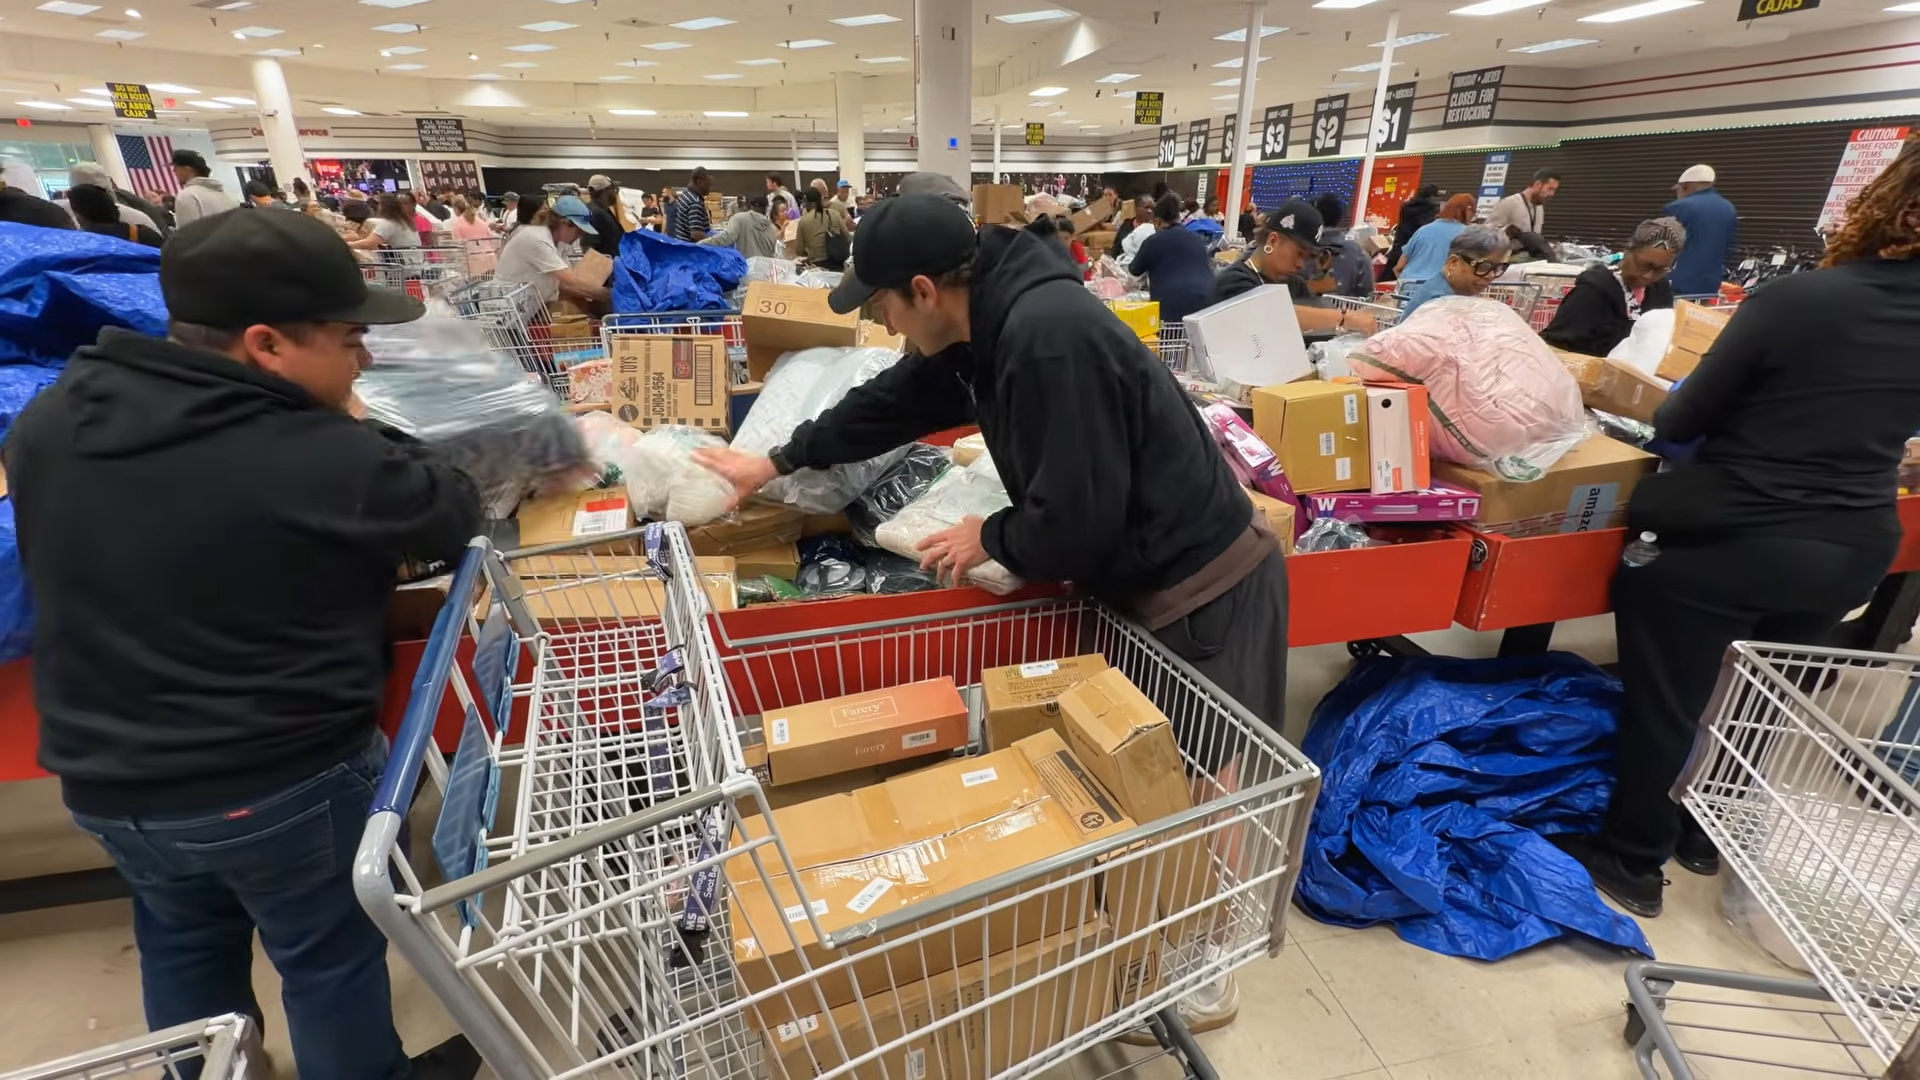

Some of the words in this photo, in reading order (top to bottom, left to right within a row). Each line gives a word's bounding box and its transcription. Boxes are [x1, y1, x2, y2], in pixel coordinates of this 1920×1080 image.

[1756, 0, 1803, 15] CAJAS
[110, 91, 129, 100] OPEN
[114, 84, 126, 92] DO
[1450, 91, 1477, 107] CLOSED
[1479, 88, 1495, 104] FOR
[129, 102, 153, 110] ABRIR
[124, 110, 148, 118] CAJAS
[1446, 105, 1492, 123] RESTOCKING
[1314, 114, 1339, 153] $2
[1376, 104, 1402, 149] $1
[1265, 121, 1285, 157] $3
[1857, 128, 1900, 141] CAUTION
[1158, 139, 1175, 165] $10
[1190, 133, 1206, 163] $7
[1849, 143, 1872, 151] SOME
[1873, 142, 1899, 150] FOOD
[1853, 167, 1876, 175] THEIR
[1854, 175, 1865, 183] BY
[759, 300, 787, 315] 30
[620, 356, 638, 373] TOYS
[1316, 498, 1337, 512] W
[1577, 488, 1600, 532] amazo
[703, 880, 715, 898] Seat
